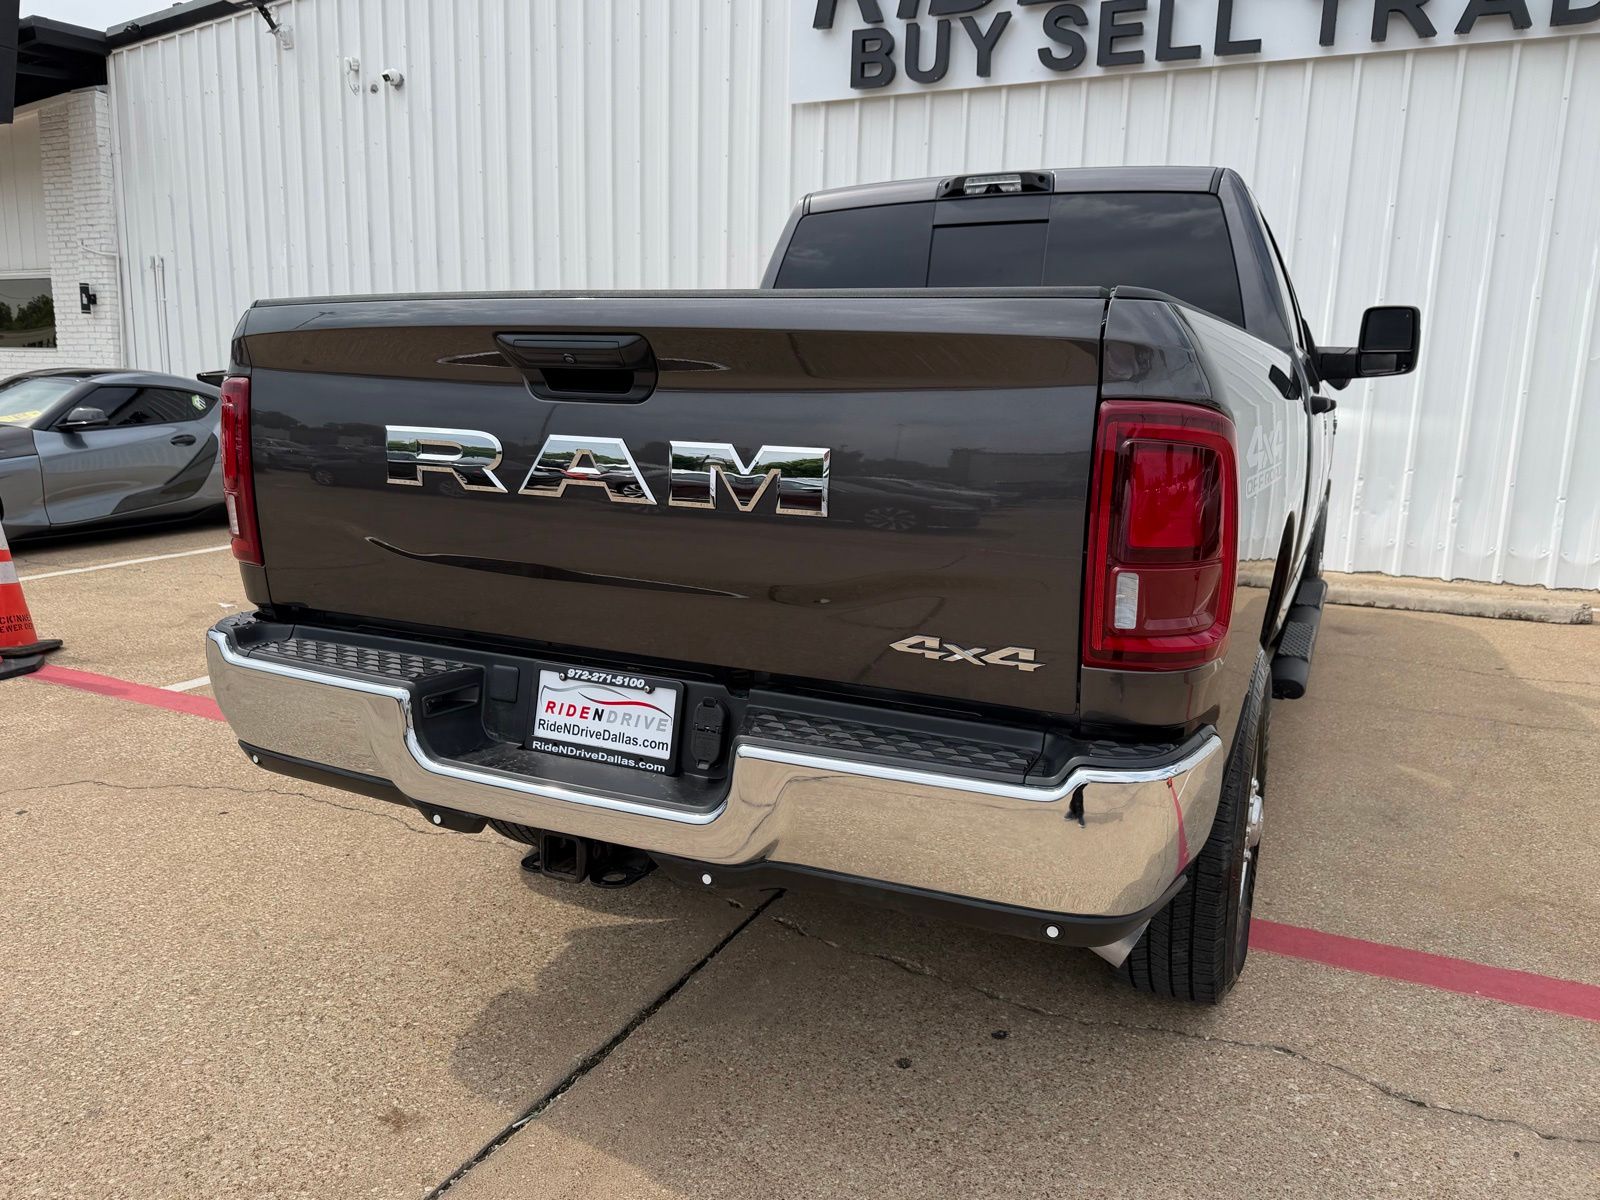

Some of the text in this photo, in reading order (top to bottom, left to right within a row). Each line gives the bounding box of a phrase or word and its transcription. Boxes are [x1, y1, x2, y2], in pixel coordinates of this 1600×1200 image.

[850, 11, 1012, 89] BUY
[1038, 0, 1262, 71] SELL
[385, 425, 831, 517] RAM
[567, 668, 645, 689] 972-271-5100
[537, 718, 669, 752] RideNDriveDallas.com
[532, 740, 666, 773] RideNDriveDallas.com
